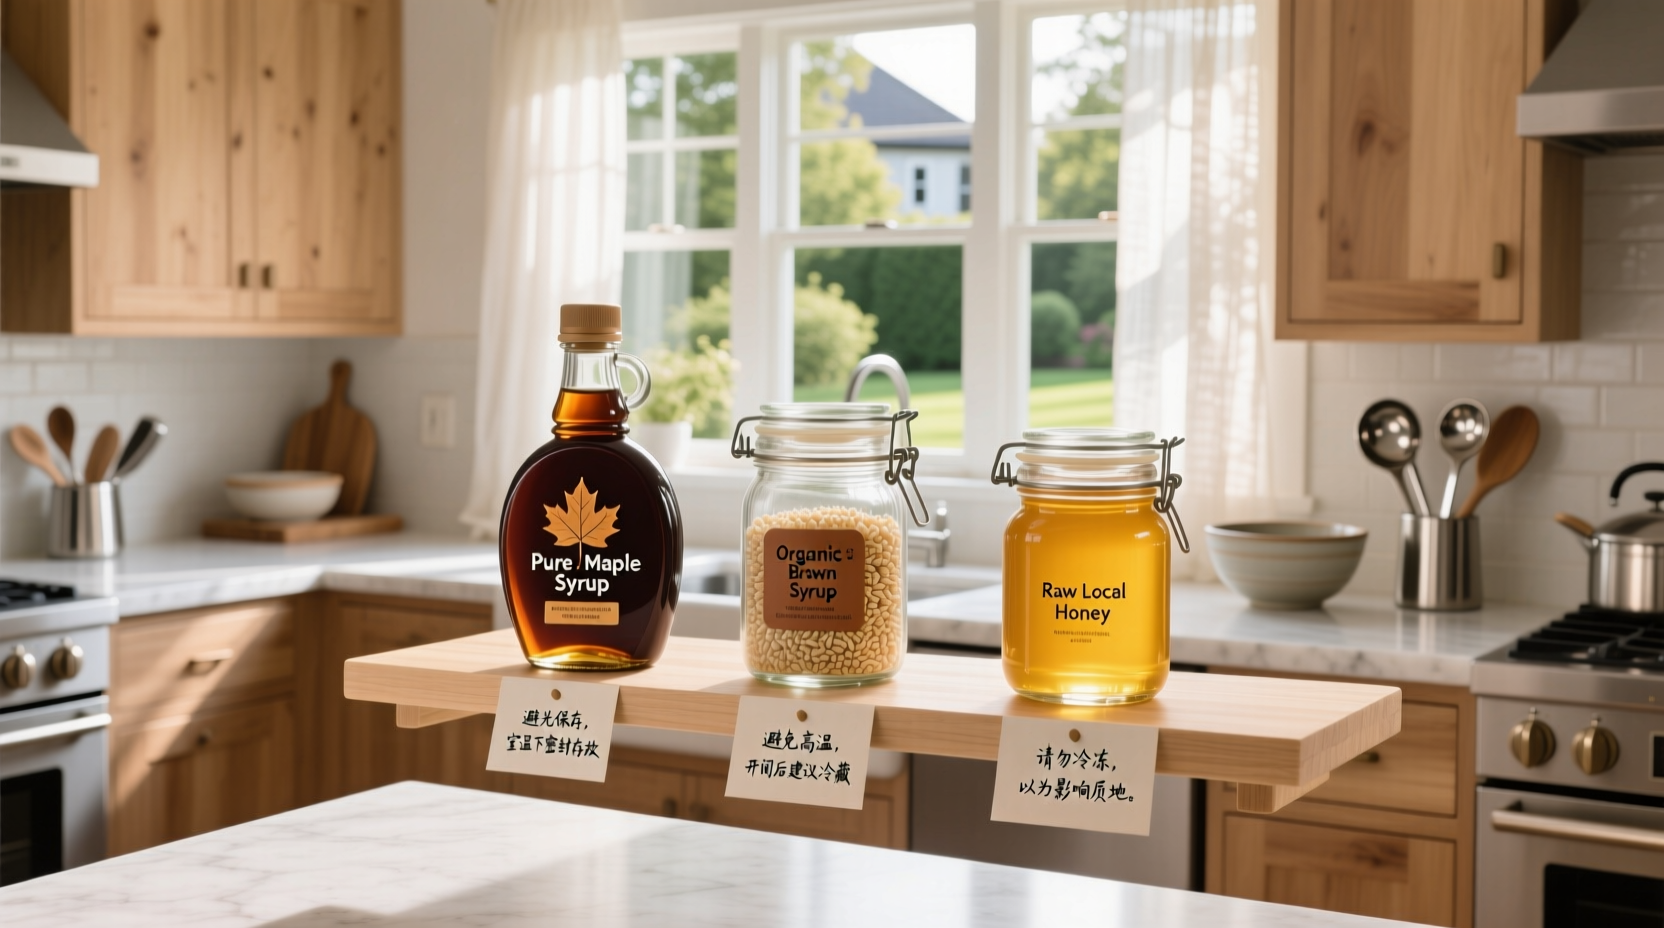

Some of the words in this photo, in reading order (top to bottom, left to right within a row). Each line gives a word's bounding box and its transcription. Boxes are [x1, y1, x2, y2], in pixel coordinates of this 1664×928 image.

[531, 552, 573, 571] Pure
[584, 553, 642, 576] Maple
[776, 545, 842, 566] Organic
[554, 573, 610, 597] Syrup
[789, 582, 837, 603] Syrup
[1042, 582, 1077, 599] Raw
[1083, 582, 1126, 599] Local
[1055, 603, 1111, 626] Honey
[761, 728, 839, 754] 避免高温，
[1036, 743, 1116, 772] 请勿冷冻，
[1019, 777, 1134, 803] 以为影响质地。
